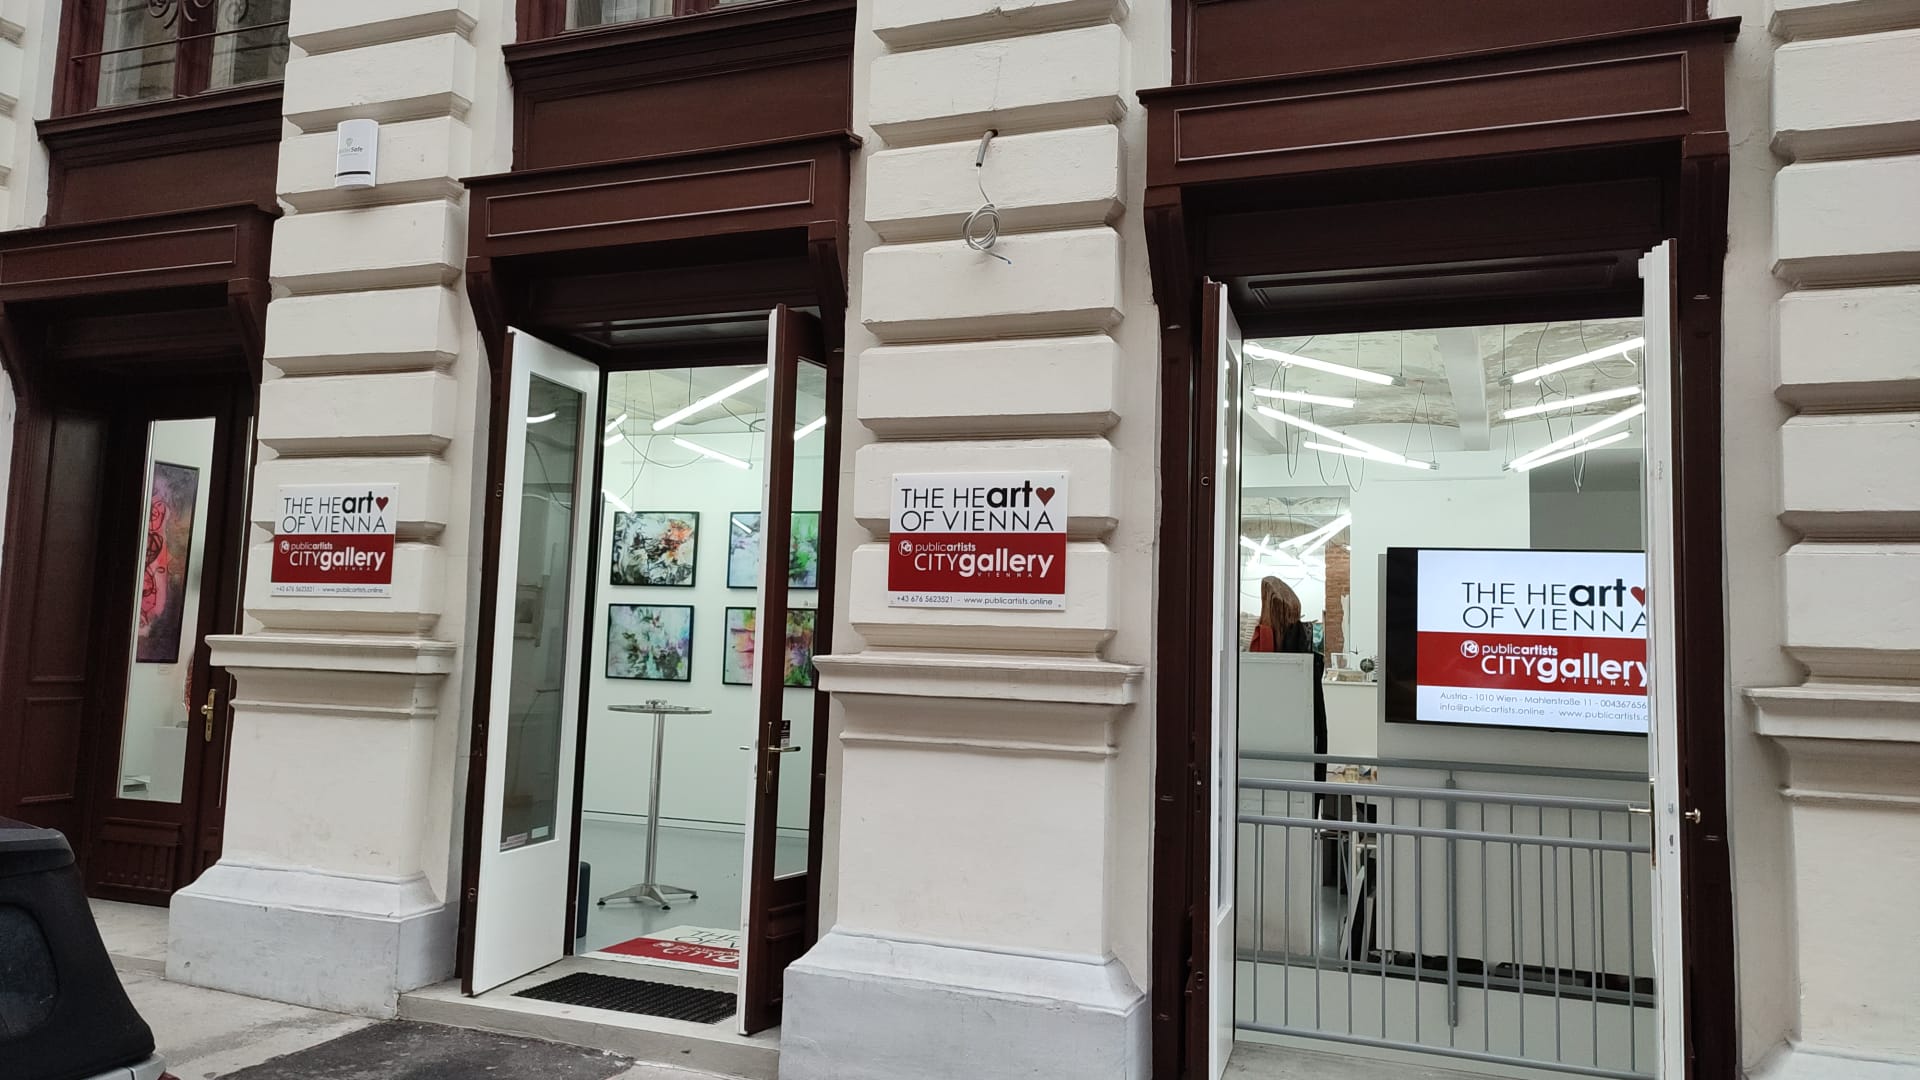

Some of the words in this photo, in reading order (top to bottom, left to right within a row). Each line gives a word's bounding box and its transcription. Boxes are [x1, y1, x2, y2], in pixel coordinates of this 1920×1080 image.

[284, 497, 313, 514] THE
[319, 491, 374, 514] HEart
[901, 488, 944, 508] THE
[953, 480, 1033, 508] HEart
[282, 516, 306, 533] OF
[311, 516, 387, 533] VIENNA
[901, 510, 935, 531] OF
[942, 510, 1054, 531] VIENNA
[291, 542, 333, 551] publicartists
[915, 542, 976, 553] publicartists
[289, 547, 386, 571] CITYgallery
[914, 548, 1055, 578] CITYgallery
[925, 596, 953, 604] 5623521
[963, 597, 1053, 605] www.publicartists.online
[1461, 582, 1515, 605] THE
[1528, 578, 1626, 607] HEart
[1462, 606, 1504, 629] OF
[1514, 607, 1647, 633] VIENNA
[1482, 643, 1558, 656] publicartists
[1481, 652, 1648, 688] CITYgallery
[1561, 677, 1630, 687] VIENNA
[1440, 692, 1468, 701] Austria
[1476, 693, 1495, 701] 1010
[1496, 694, 1518, 702] Wien
[1600, 699, 1647, 709] 004367656
[1439, 703, 1545, 716] info@publicartists.online
[1559, 710, 1648, 721] www.publicartists.o
